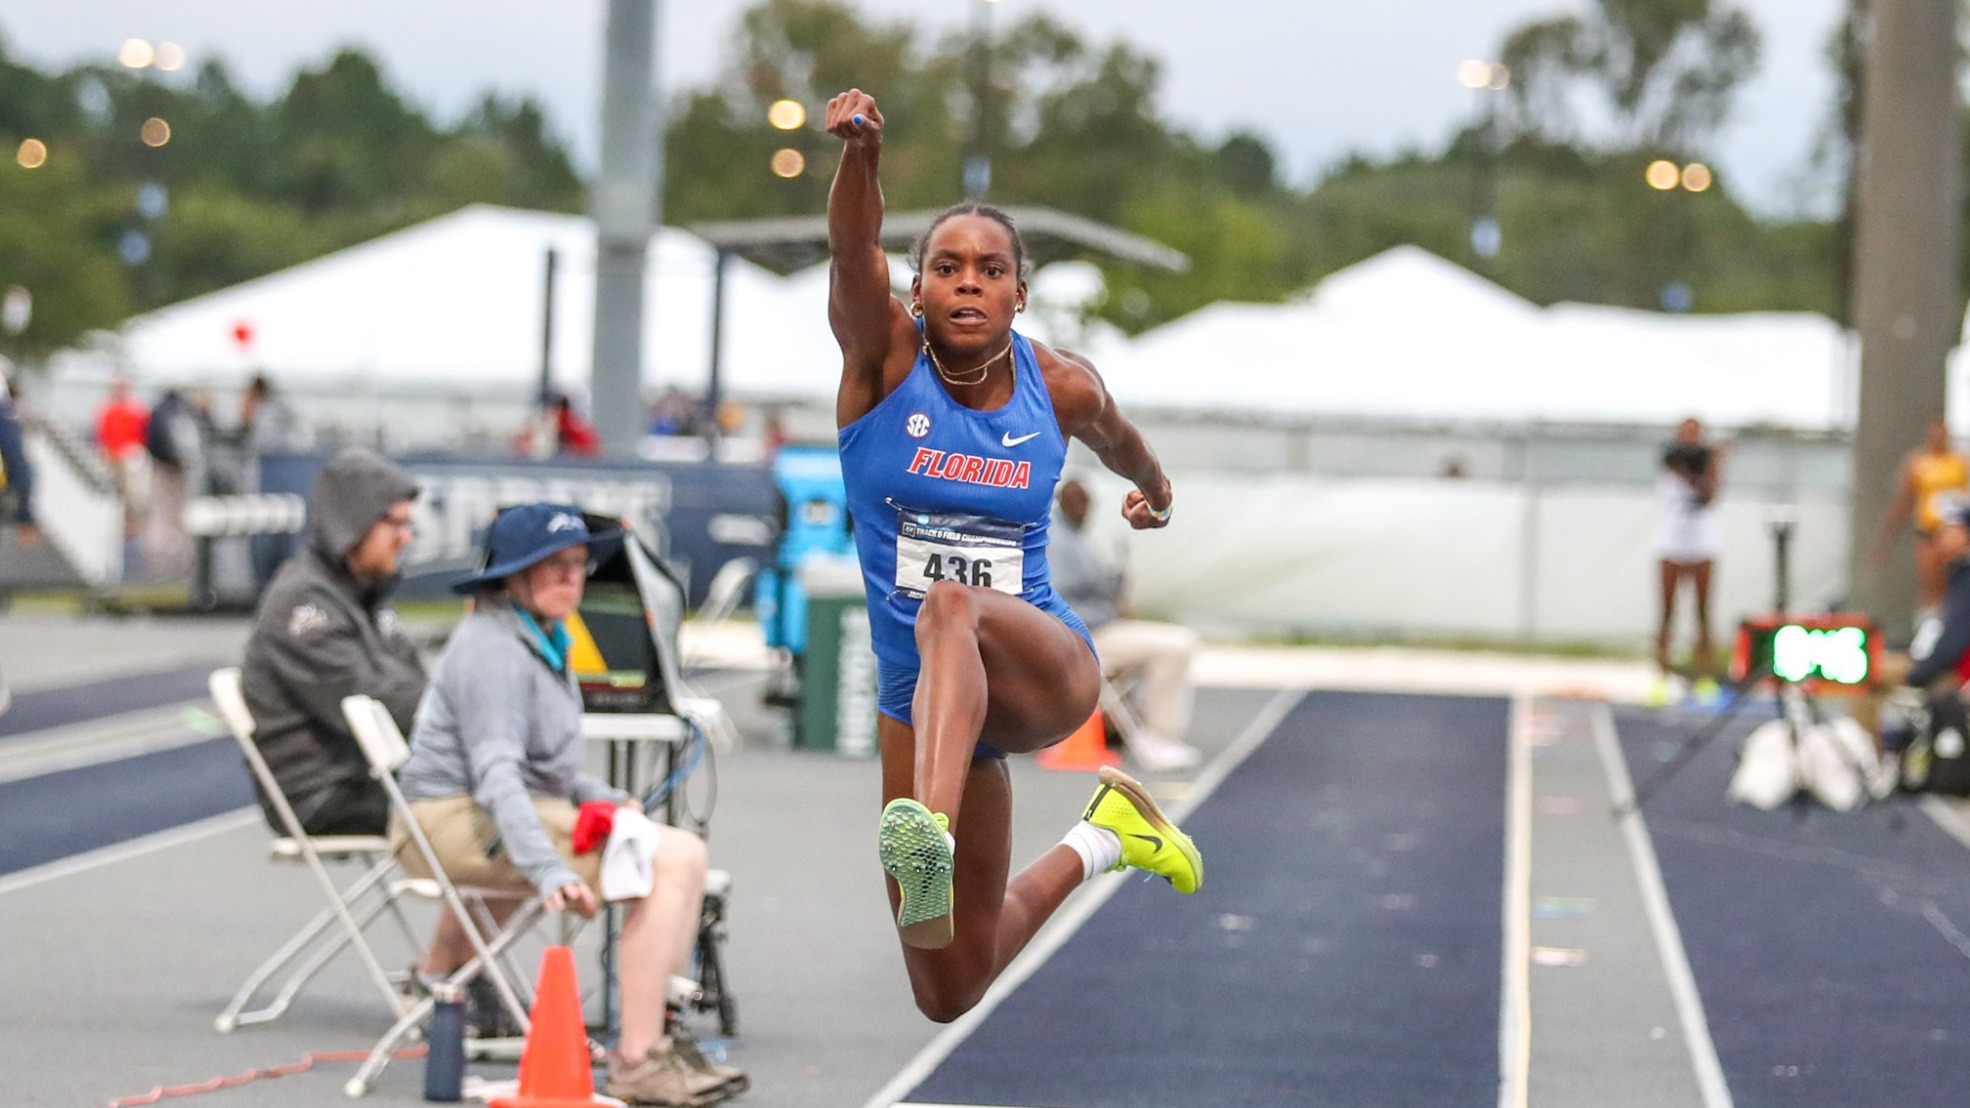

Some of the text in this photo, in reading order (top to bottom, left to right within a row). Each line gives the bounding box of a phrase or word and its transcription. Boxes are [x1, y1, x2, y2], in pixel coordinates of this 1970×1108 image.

[907, 414, 930, 437] SEC
[907, 447, 1031, 489] FLORIDA
[943, 531, 961, 540] FIELD
[923, 553, 992, 588] 436
